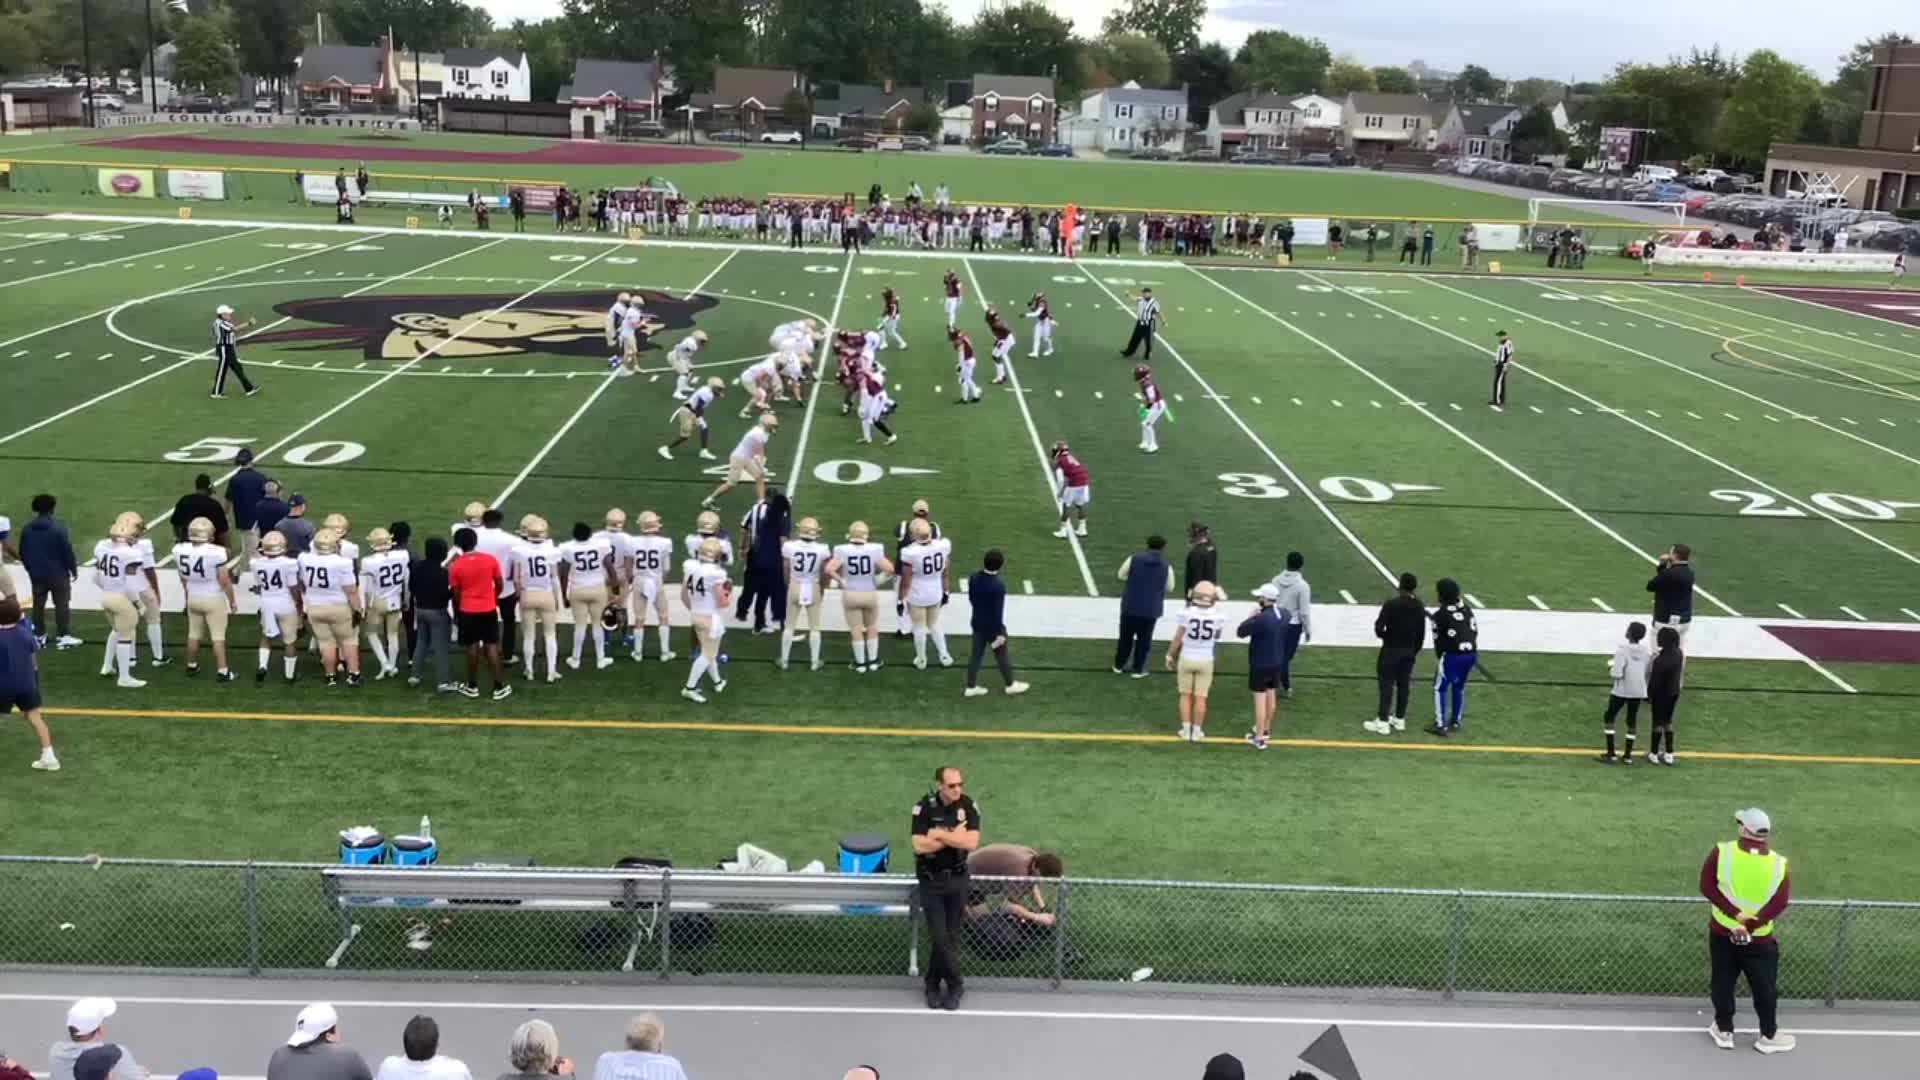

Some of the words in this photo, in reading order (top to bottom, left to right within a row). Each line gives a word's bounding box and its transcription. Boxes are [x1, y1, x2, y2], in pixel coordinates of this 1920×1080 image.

[169, 115, 272, 123] COLLEGIATE
[1217, 472, 1393, 502] 30
[1709, 489, 1896, 519] 20
[97, 554, 119, 577] 46
[180, 555, 205, 578] 54
[528, 556, 547, 577] 16
[574, 550, 599, 571] 52
[636, 550, 659, 569] 26
[793, 552, 817, 573] 37
[847, 555, 871, 575] 50
[923, 552, 943, 575] 60
[257, 570, 282, 590] 34
[305, 566, 329, 588] 79
[379, 563, 403, 588] 22
[686, 574, 705, 597] 44
[1187, 618, 1213, 640] 35
